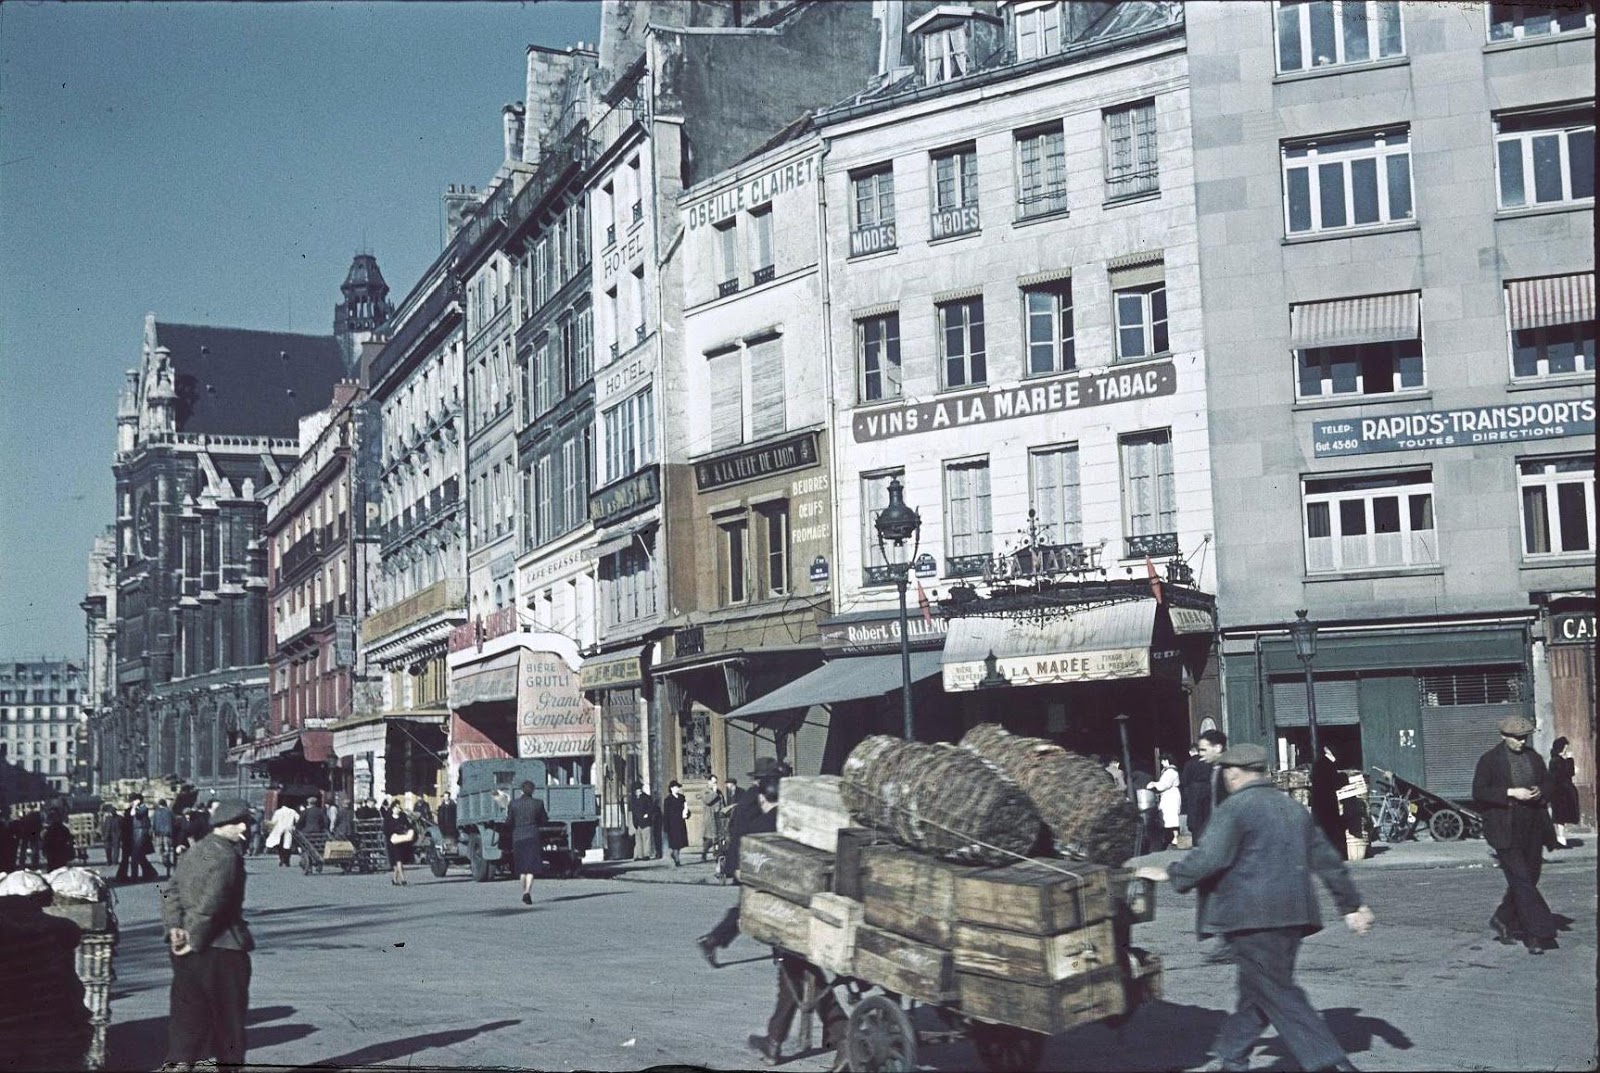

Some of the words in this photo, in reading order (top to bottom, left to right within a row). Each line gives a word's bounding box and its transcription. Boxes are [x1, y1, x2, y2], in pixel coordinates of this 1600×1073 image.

[689, 186, 745, 231] OSEILLE
[751, 157, 814, 205] CLAIRET
[933, 207, 979, 237] MODES
[852, 225, 896, 254] MODES
[604, 235, 644, 279] HOTEL
[606, 360, 646, 395] HOTEL
[866, 409, 918, 437] VINS
[932, 403, 950, 428] A
[957, 397, 986, 425] LA
[994, 381, 1080, 419] MARÉE
[1096, 370, 1158, 401] TABAC
[1398, 436, 1455, 448] TOUTES
[1473, 426, 1565, 442] DIRECTIONS
[722, 461, 735, 481] LA
[759, 452, 773, 472] DE
[773, 445, 797, 469] LION
[792, 474, 828, 496] BEURRES
[847, 625, 889, 642] Robert
[1036, 657, 1090, 675] MARÉE
[536, 691, 582, 711] Grand
